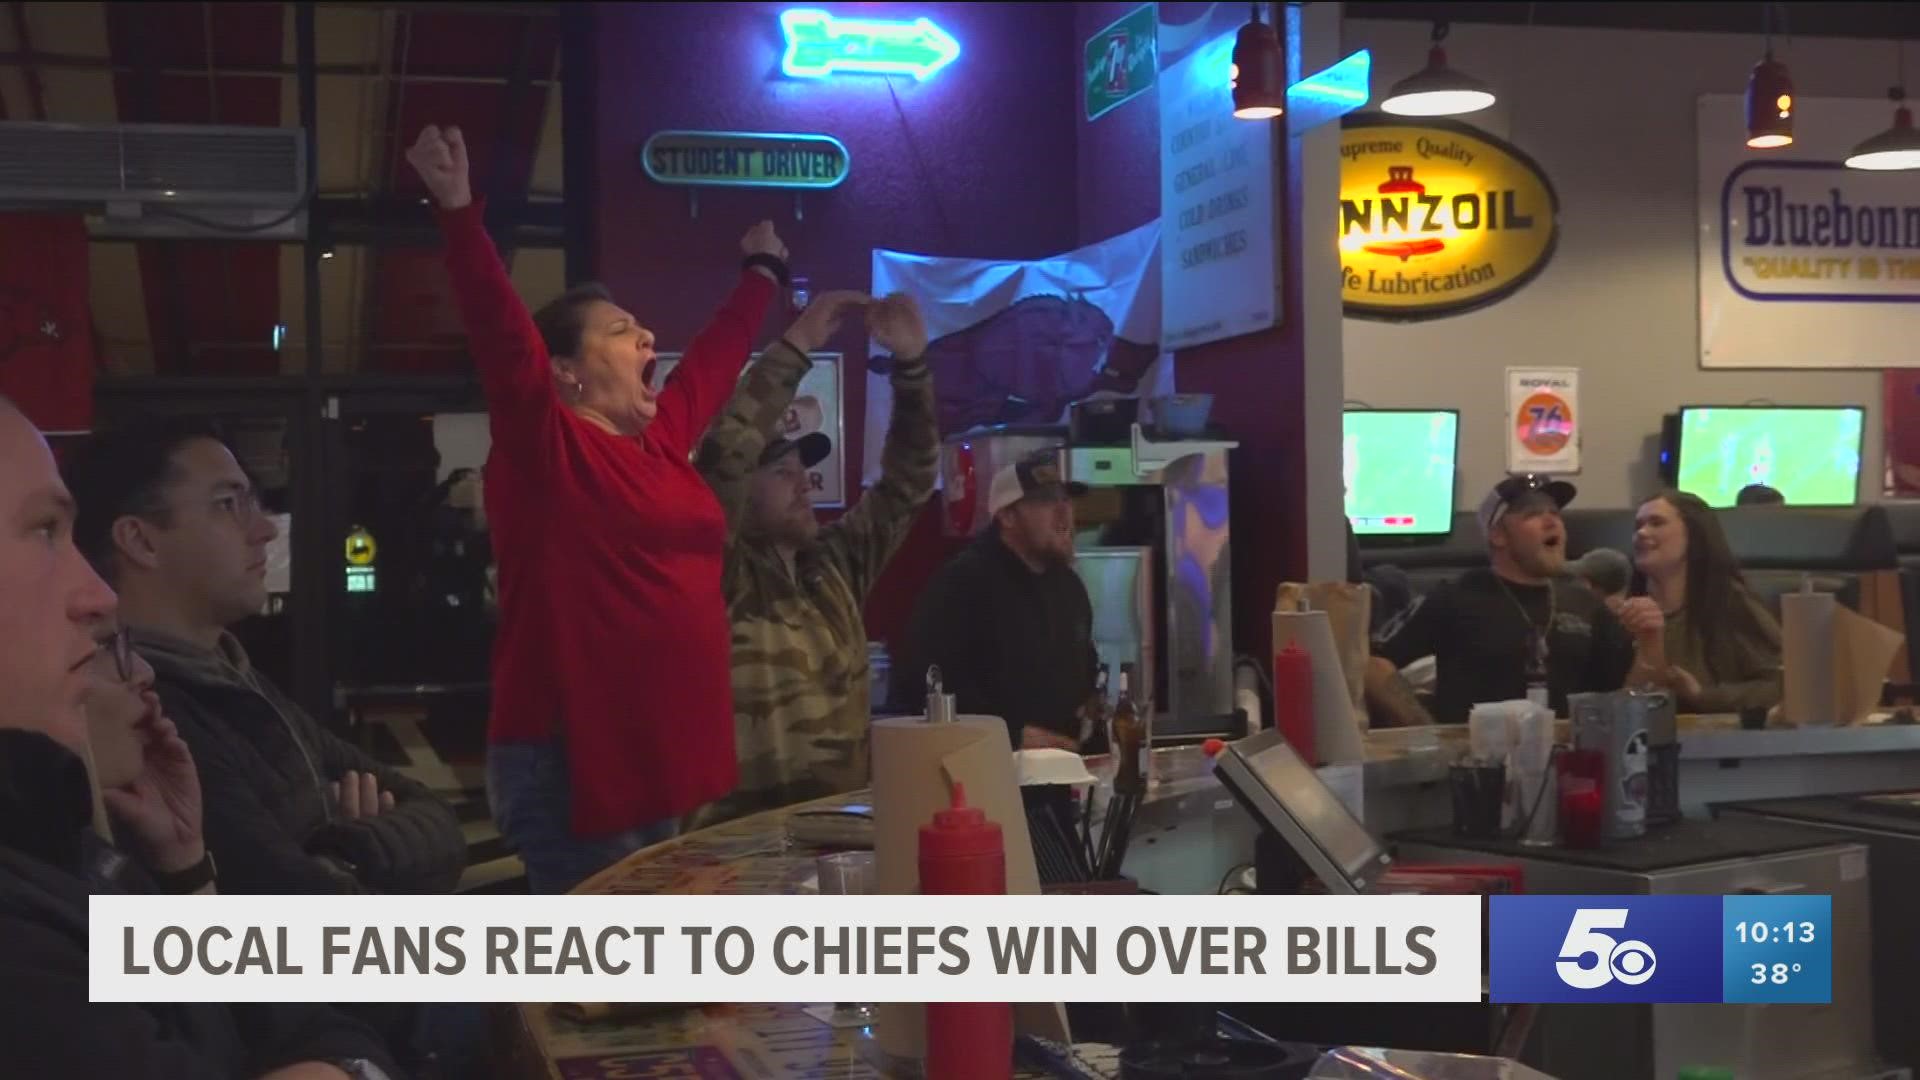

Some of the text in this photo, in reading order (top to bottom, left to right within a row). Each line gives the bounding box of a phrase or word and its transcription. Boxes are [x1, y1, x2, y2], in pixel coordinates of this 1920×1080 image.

[653, 147, 836, 177] STUDENT DRIVER
[1416, 137, 1475, 166] Quality
[1367, 262, 1496, 294] Lubrication
[1529, 405, 1564, 434] 76
